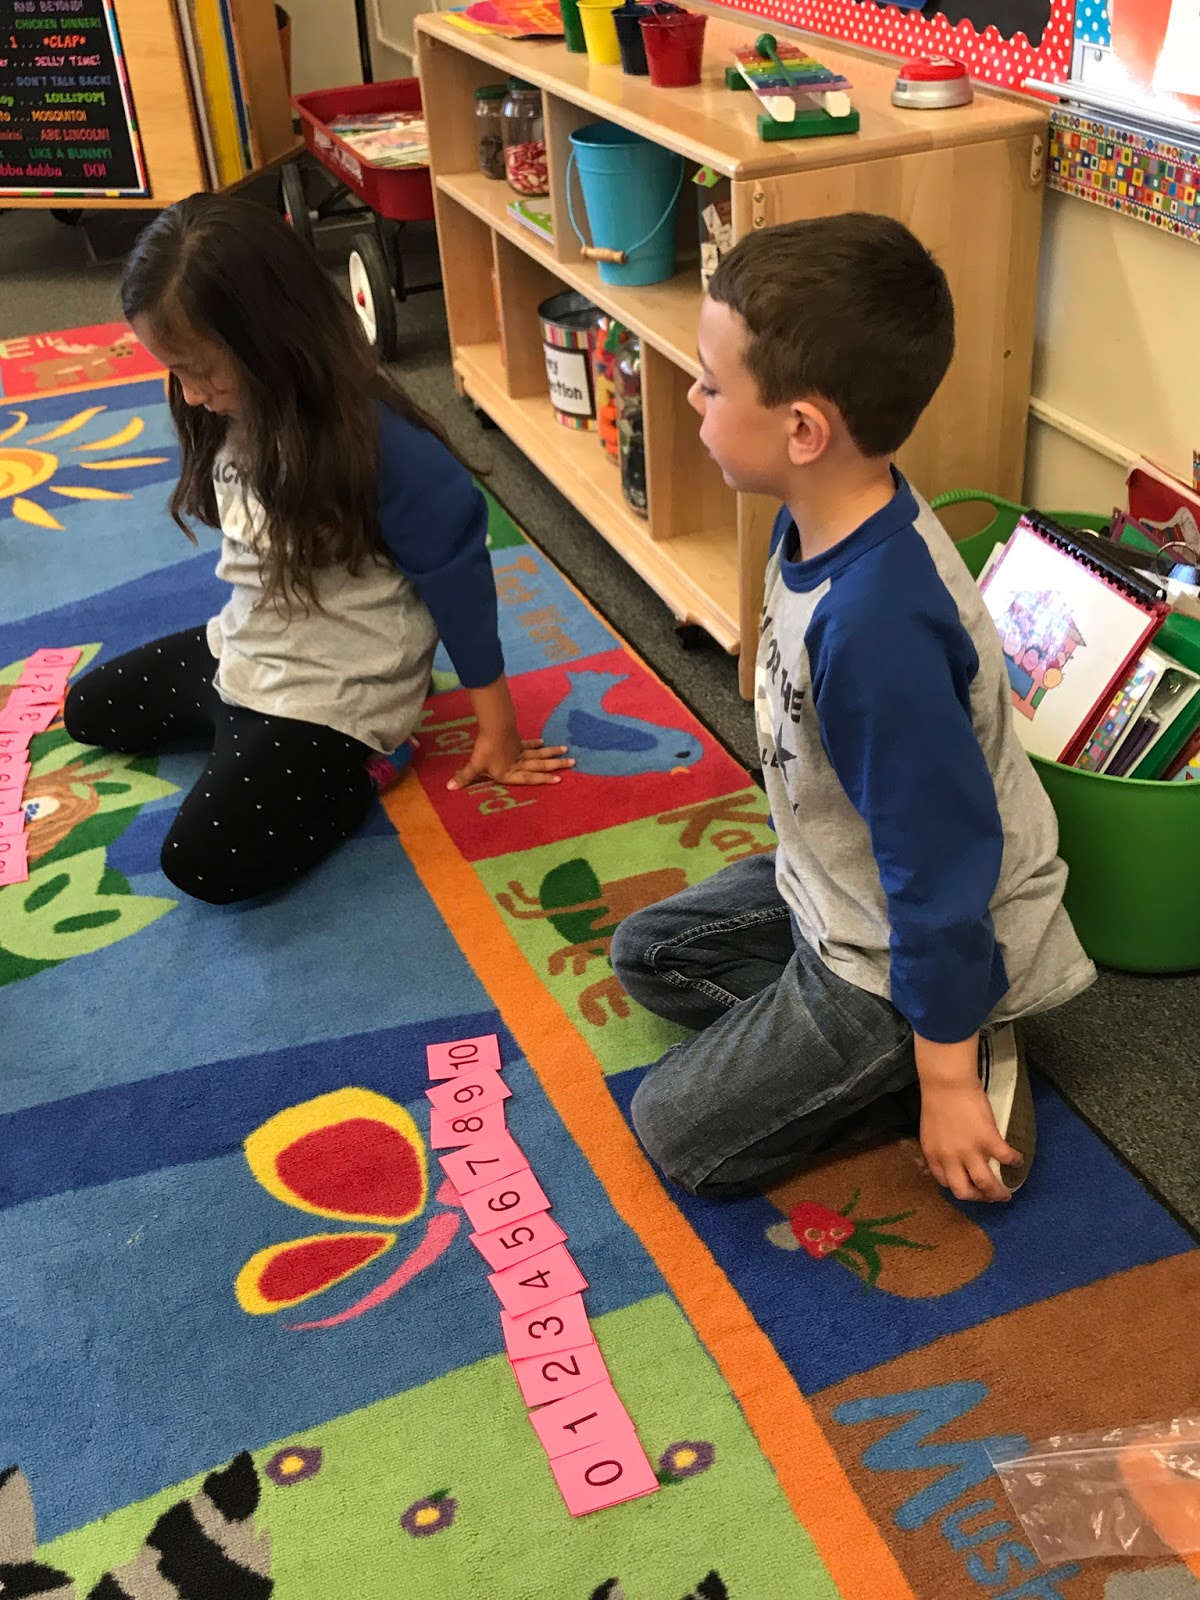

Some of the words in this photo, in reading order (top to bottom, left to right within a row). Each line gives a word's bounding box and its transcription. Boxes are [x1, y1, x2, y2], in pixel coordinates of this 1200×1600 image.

[10, 35, 18, 48] 1
[34, 55, 65, 67] JELLY
[51, 76, 75, 87] TALK
[41, 129, 61, 141] ABE
[29, 147, 52, 159] LIKE
[57, 147, 65, 158] A
[43, 654, 64, 664] 0
[19, 712, 41, 722] 3
[448, 1043, 480, 1071] 10
[453, 1084, 485, 1104] 9
[451, 1116, 485, 1133] 8
[465, 1157, 501, 1177] 7
[487, 1190, 522, 1213] 6
[498, 1226, 536, 1251] 5
[518, 1269, 551, 1289] 4
[527, 1316, 565, 1340] 3
[541, 1354, 581, 1383] 2
[562, 1411, 599, 1435] 1
[584, 1459, 624, 1487] 0
